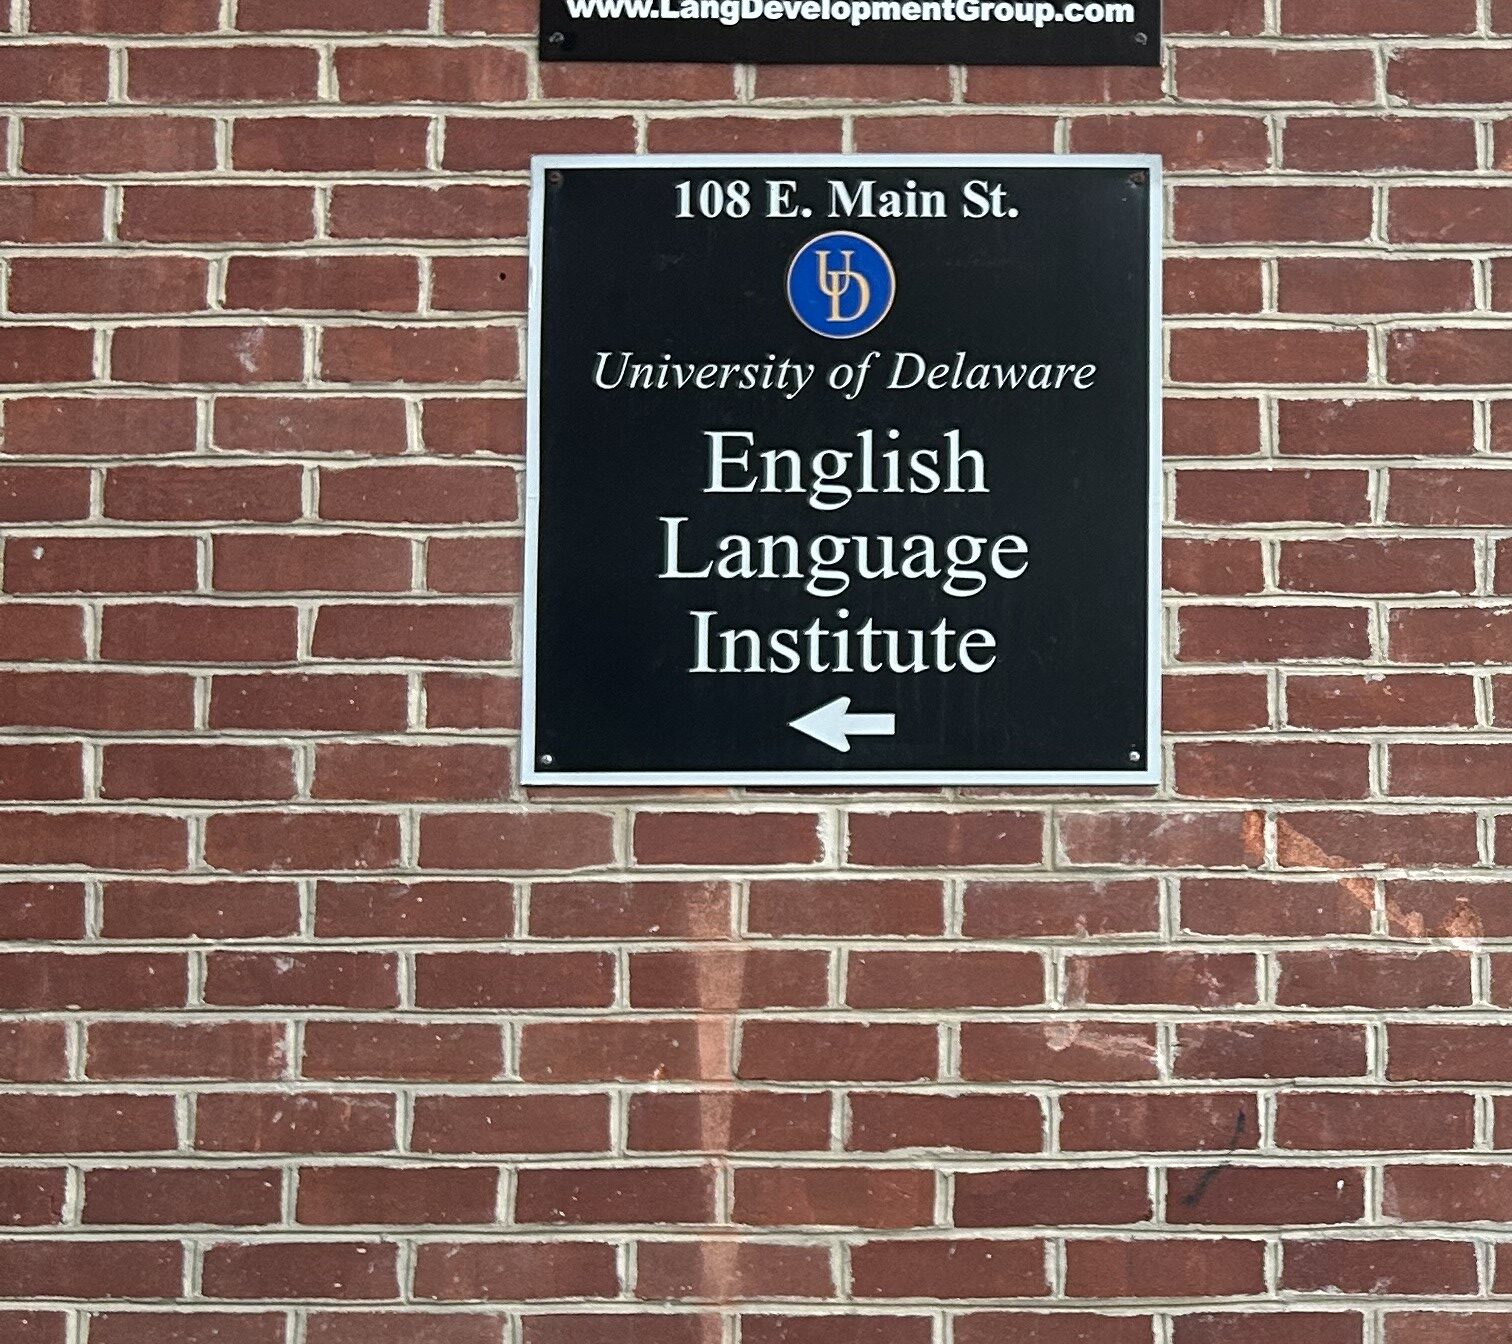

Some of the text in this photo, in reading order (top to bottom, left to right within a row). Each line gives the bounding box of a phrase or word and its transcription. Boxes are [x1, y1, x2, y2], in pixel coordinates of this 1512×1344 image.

[675, 179, 1019, 219] 108 E. Main St.
[595, 351, 1097, 400] University of Delaware
[703, 428, 990, 511] English
[658, 516, 1029, 598] Language
[688, 608, 997, 674] Institute
